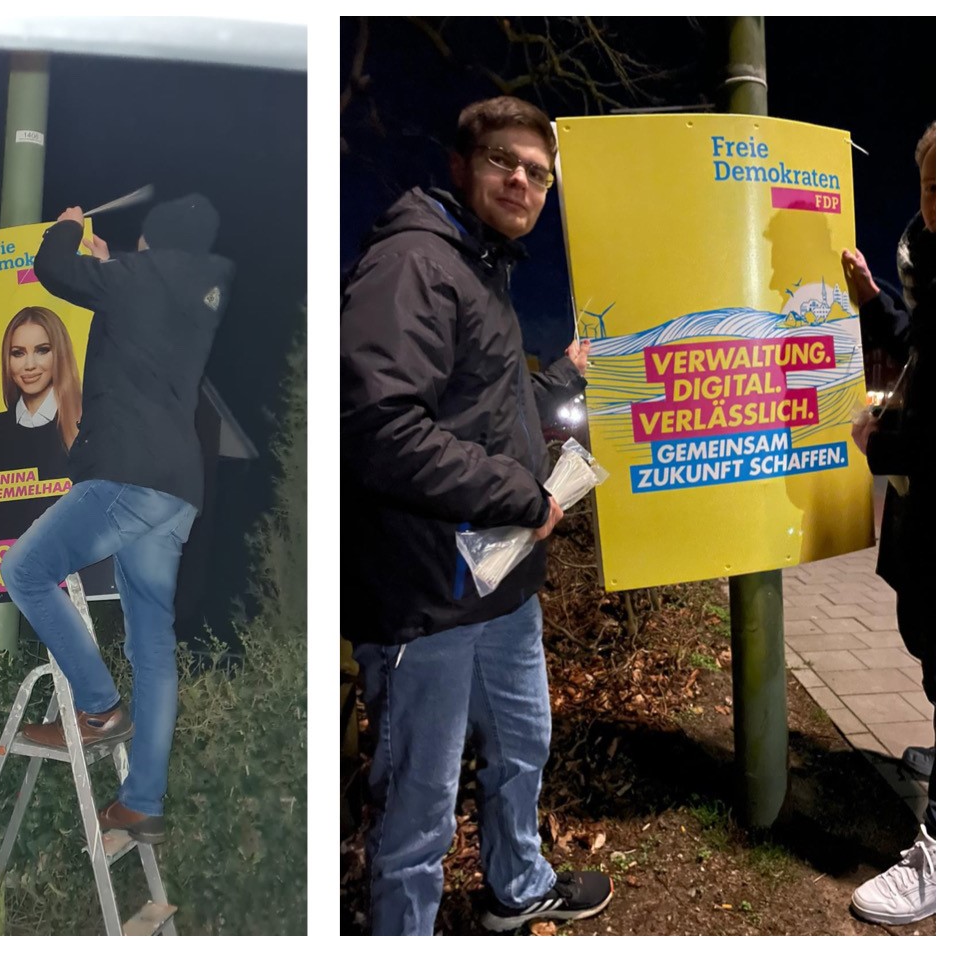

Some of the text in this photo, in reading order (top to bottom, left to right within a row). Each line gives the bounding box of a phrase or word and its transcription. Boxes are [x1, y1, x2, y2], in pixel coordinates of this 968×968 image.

[711, 136, 769, 158] Freie
[713, 161, 840, 190] Demokraten
[814, 194, 840, 210] FDP
[652, 341, 831, 376] VERWALTUNG.
[673, 372, 782, 402] DIGITAL.
[639, 398, 814, 435] VERLÄSSLICH.
[657, 433, 789, 464] GEMEINSAM
[637, 447, 846, 489] ZUKUNFT SCHAFFEN.
